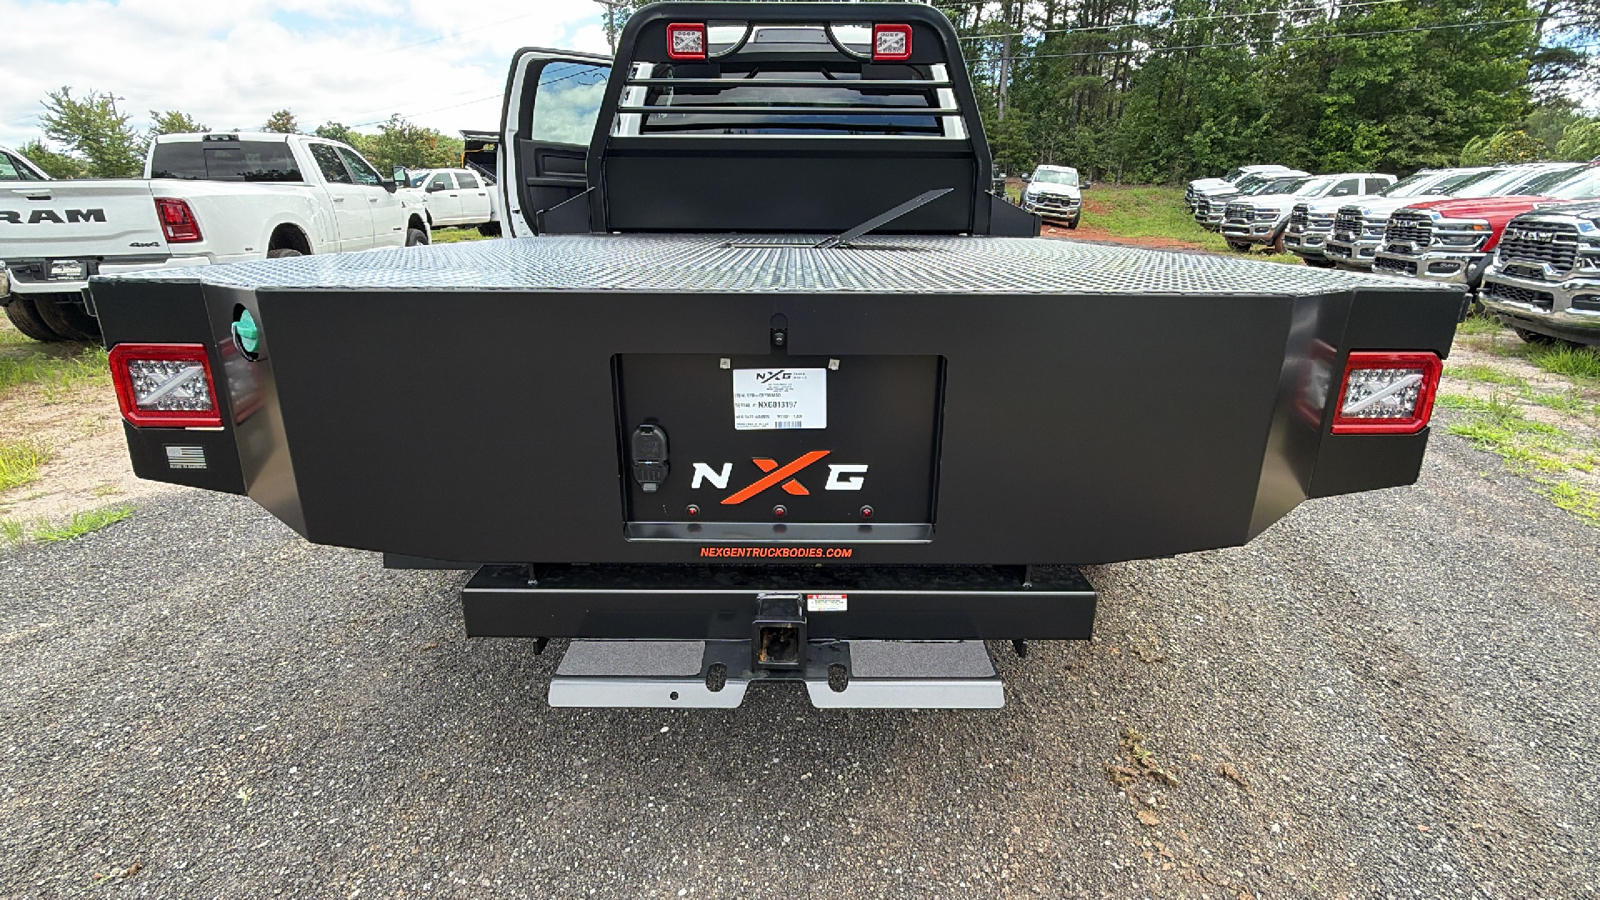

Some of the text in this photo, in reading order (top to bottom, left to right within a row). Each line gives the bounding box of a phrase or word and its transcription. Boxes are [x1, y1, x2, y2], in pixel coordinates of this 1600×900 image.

[0, 208, 107, 224] RAM
[756, 369, 792, 384] NXG
[691, 450, 869, 505] NXG
[700, 547, 852, 559] NEXGENTRUCKBODIES.COM
